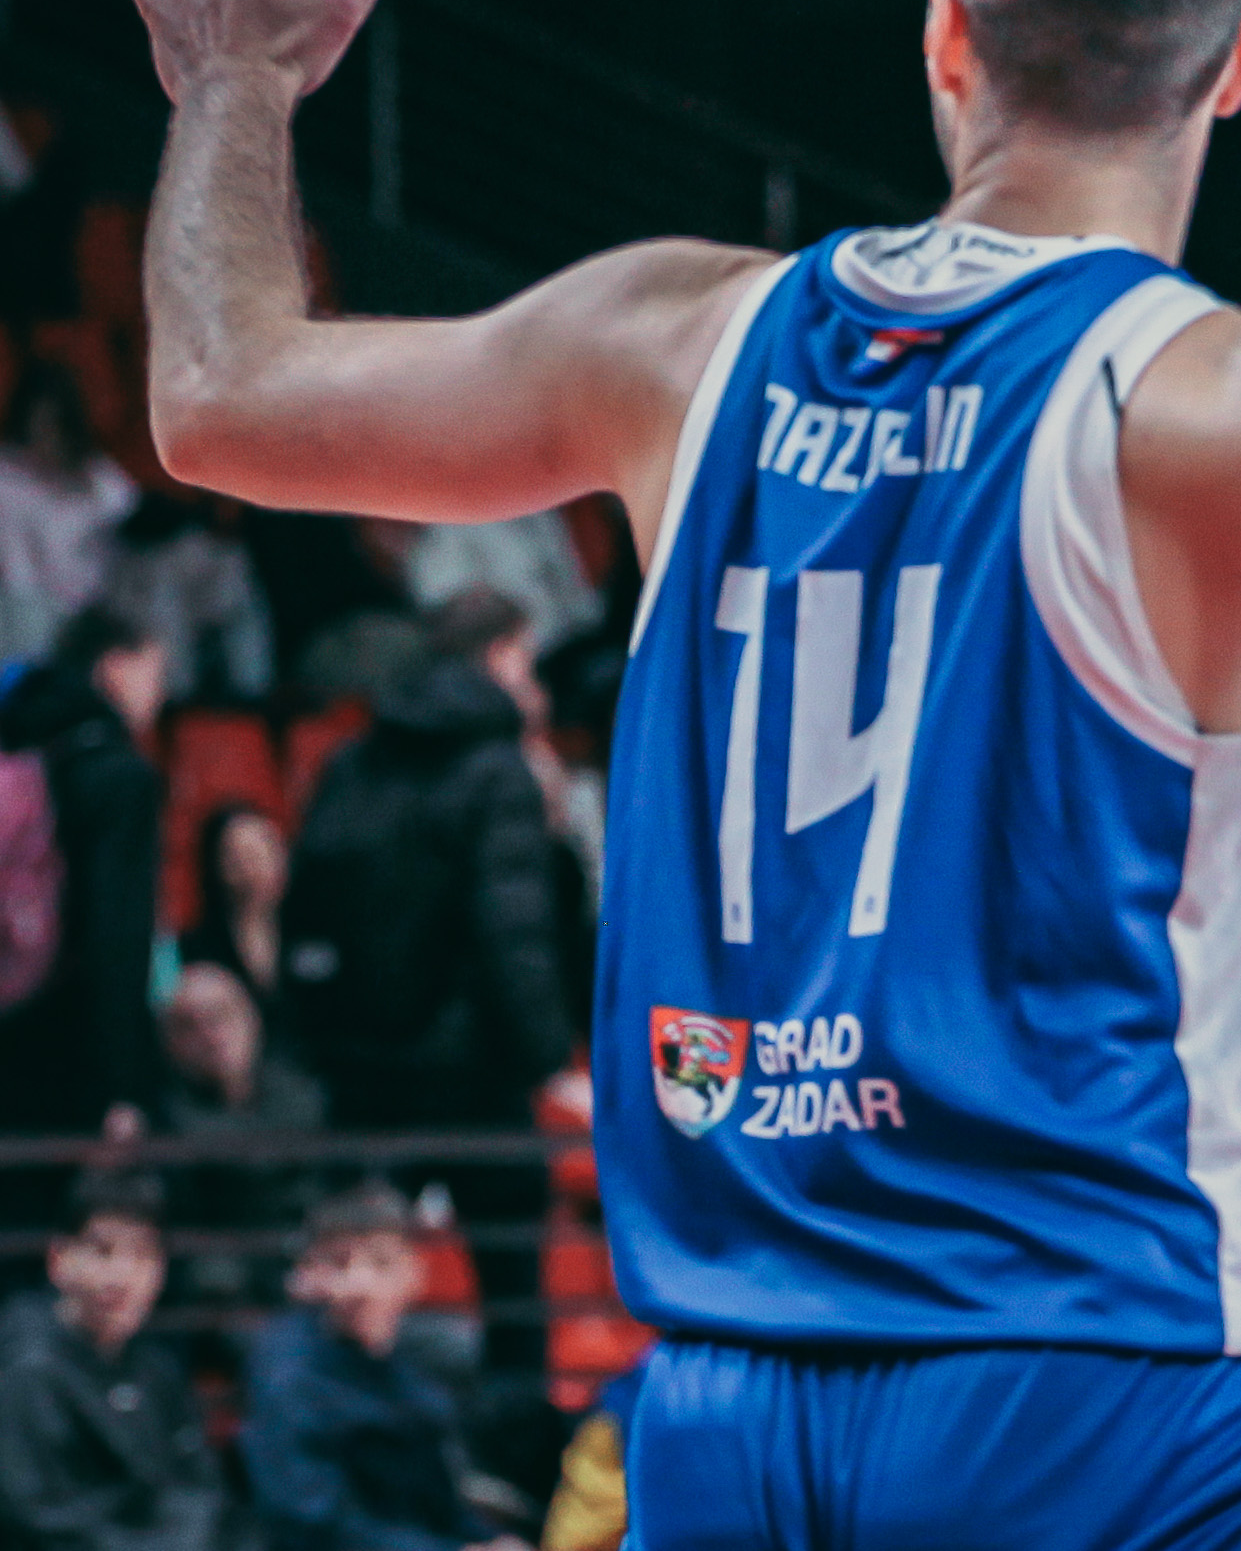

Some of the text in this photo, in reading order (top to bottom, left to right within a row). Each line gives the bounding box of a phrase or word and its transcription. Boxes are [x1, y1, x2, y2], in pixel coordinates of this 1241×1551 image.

[714, 563, 942, 945] 14
[755, 1013, 863, 1076] GRAD
[741, 1078, 905, 1139] ZADAR
